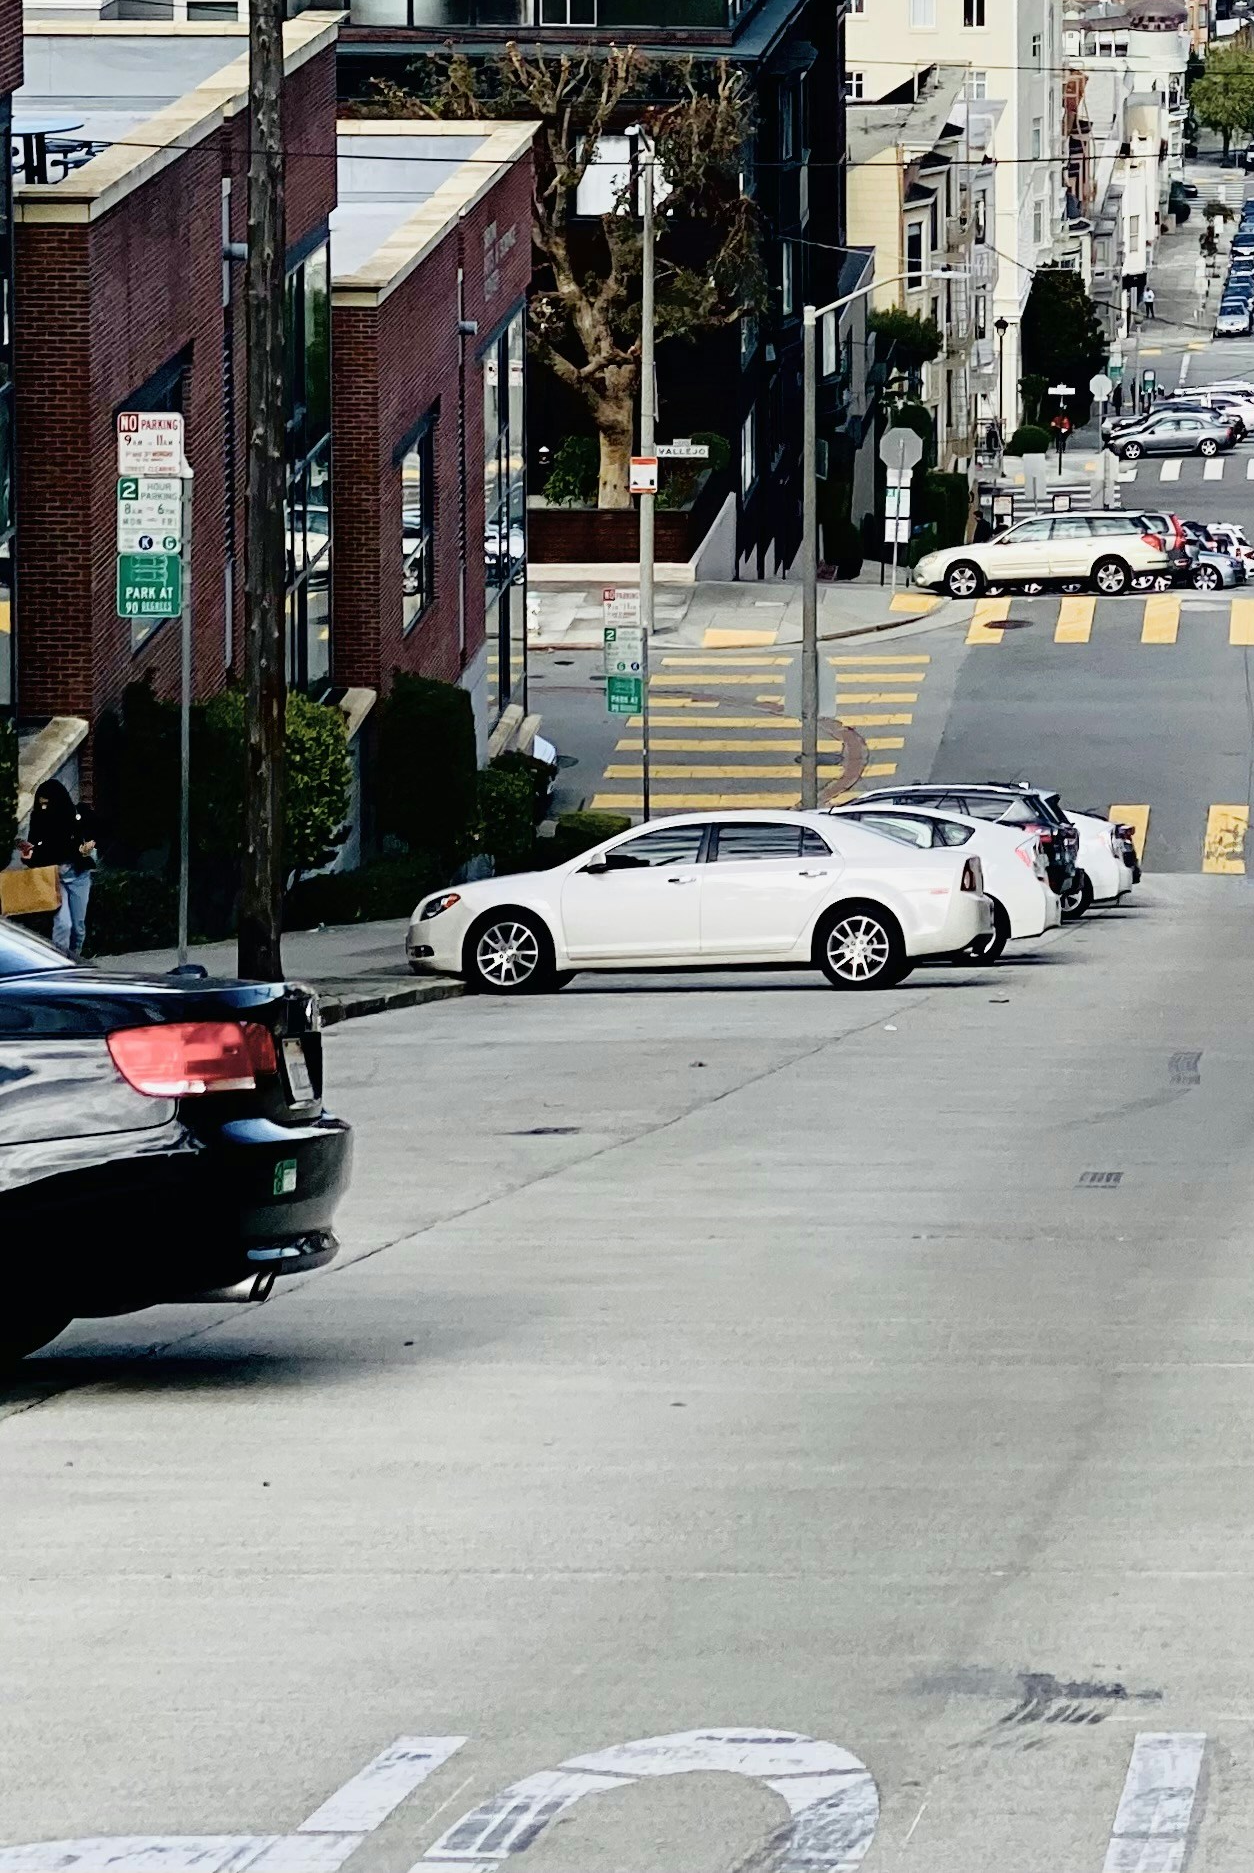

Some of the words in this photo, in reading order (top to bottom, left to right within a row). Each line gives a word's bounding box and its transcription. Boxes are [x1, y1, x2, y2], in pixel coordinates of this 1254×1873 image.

[120, 415, 138, 432] NO
[141, 419, 178, 430] PARKING
[658, 447, 706, 455] VALLEJO
[122, 482, 136, 498] 2
[147, 483, 171, 491] HOUR
[140, 492, 178, 500] PARKING
[140, 536, 151, 549] K
[164, 537, 175, 549] G
[125, 586, 156, 599] PARK
[159, 586, 174, 599] AT
[125, 601, 139, 614] 90
[606, 630, 615, 641] 2
